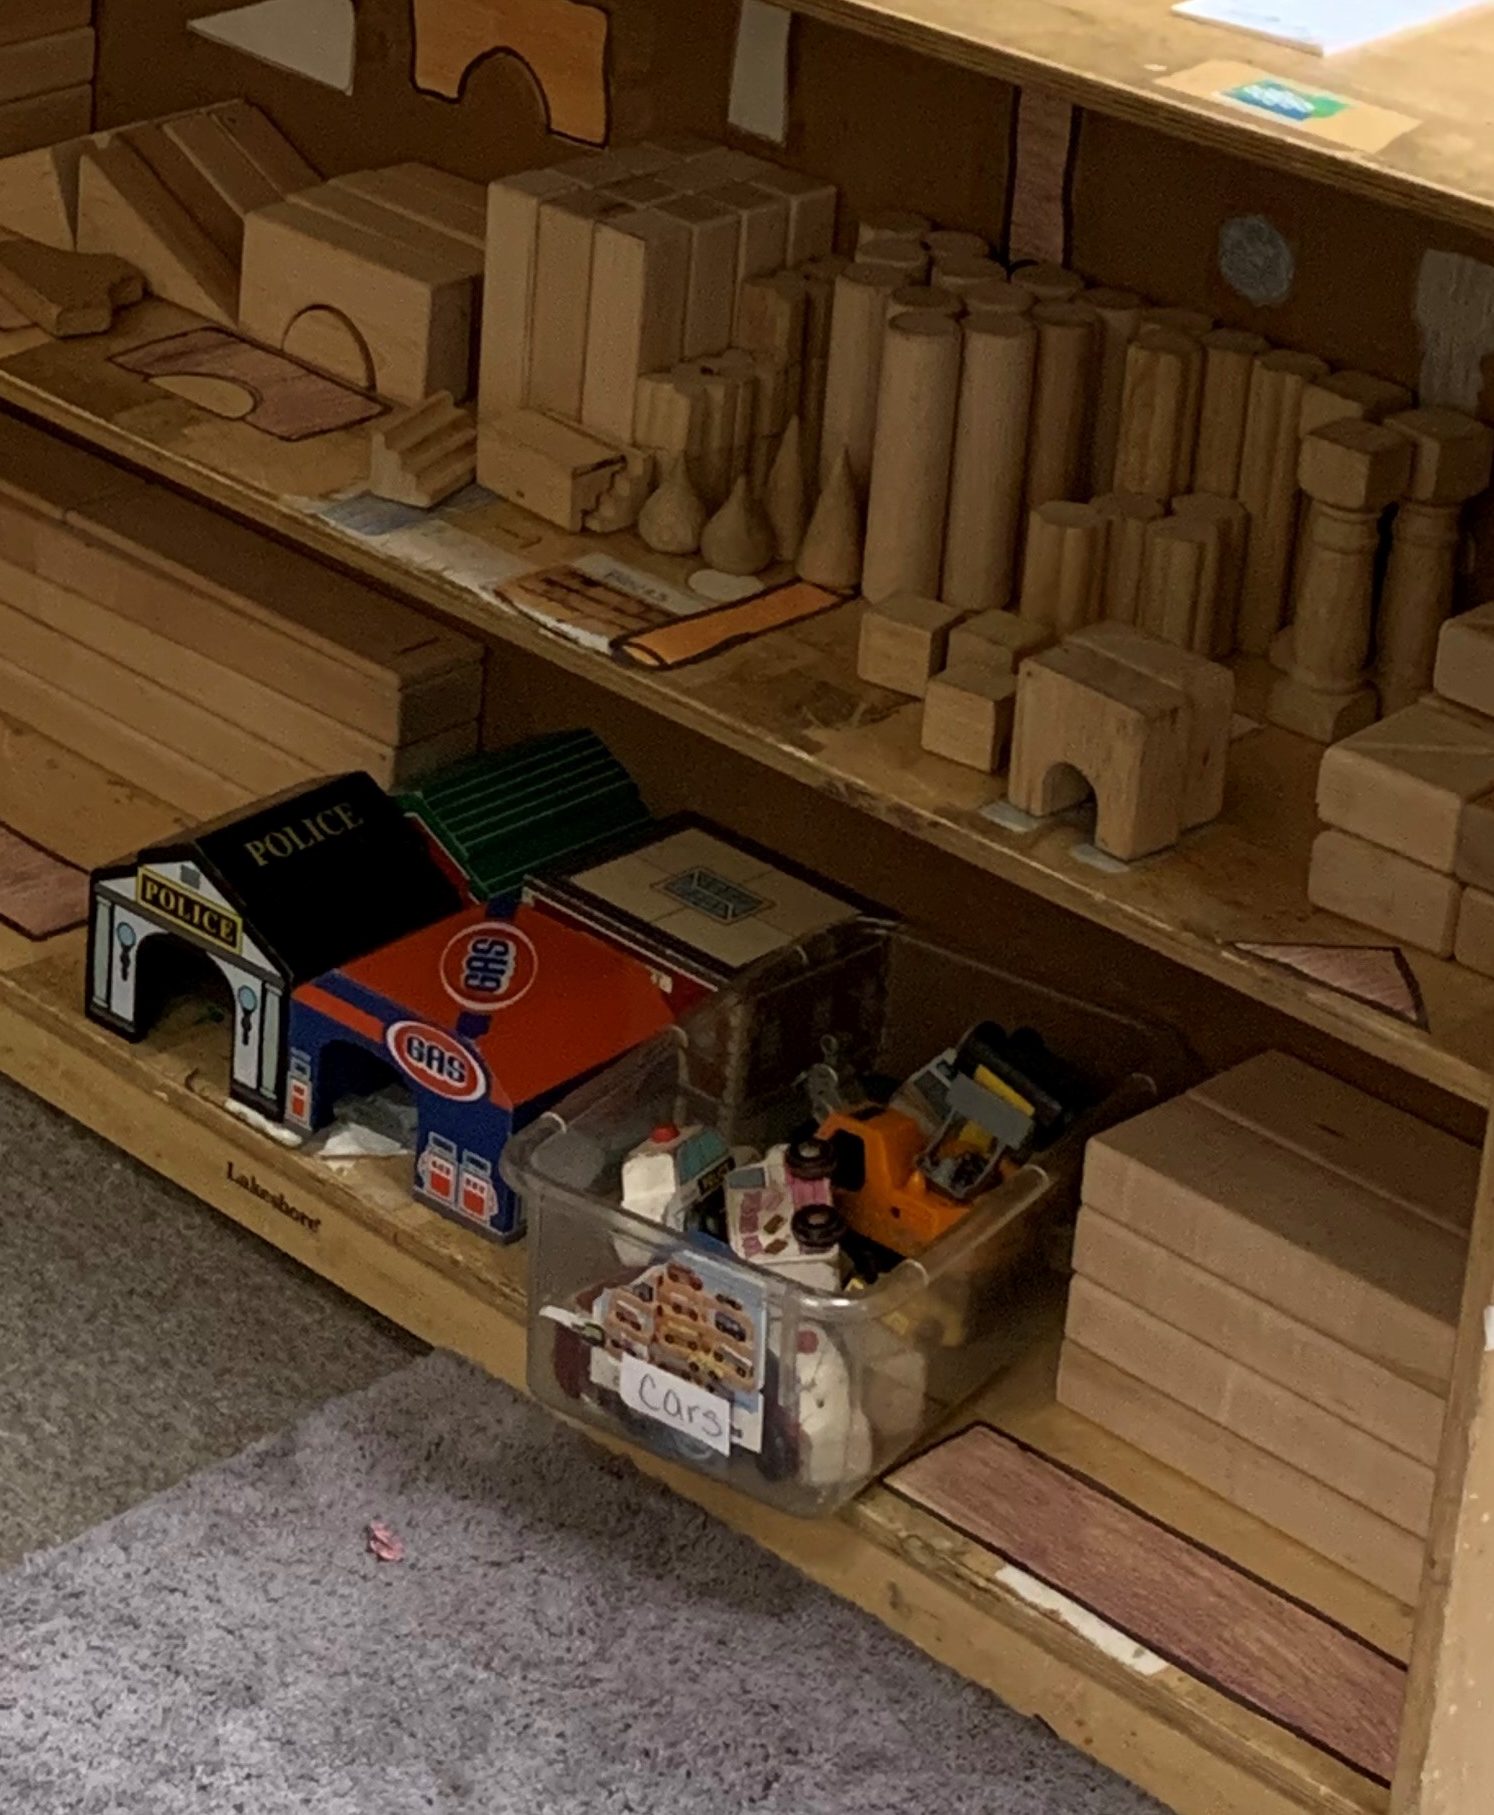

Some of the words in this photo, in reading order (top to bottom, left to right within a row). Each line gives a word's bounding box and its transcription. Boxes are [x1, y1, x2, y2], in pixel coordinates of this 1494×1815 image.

[244, 803, 364, 867] POLICE
[145, 878, 235, 942] POLICE
[463, 937, 517, 995] GAS
[405, 1034, 467, 1088] GAS
[638, 1372, 724, 1438] Cars
